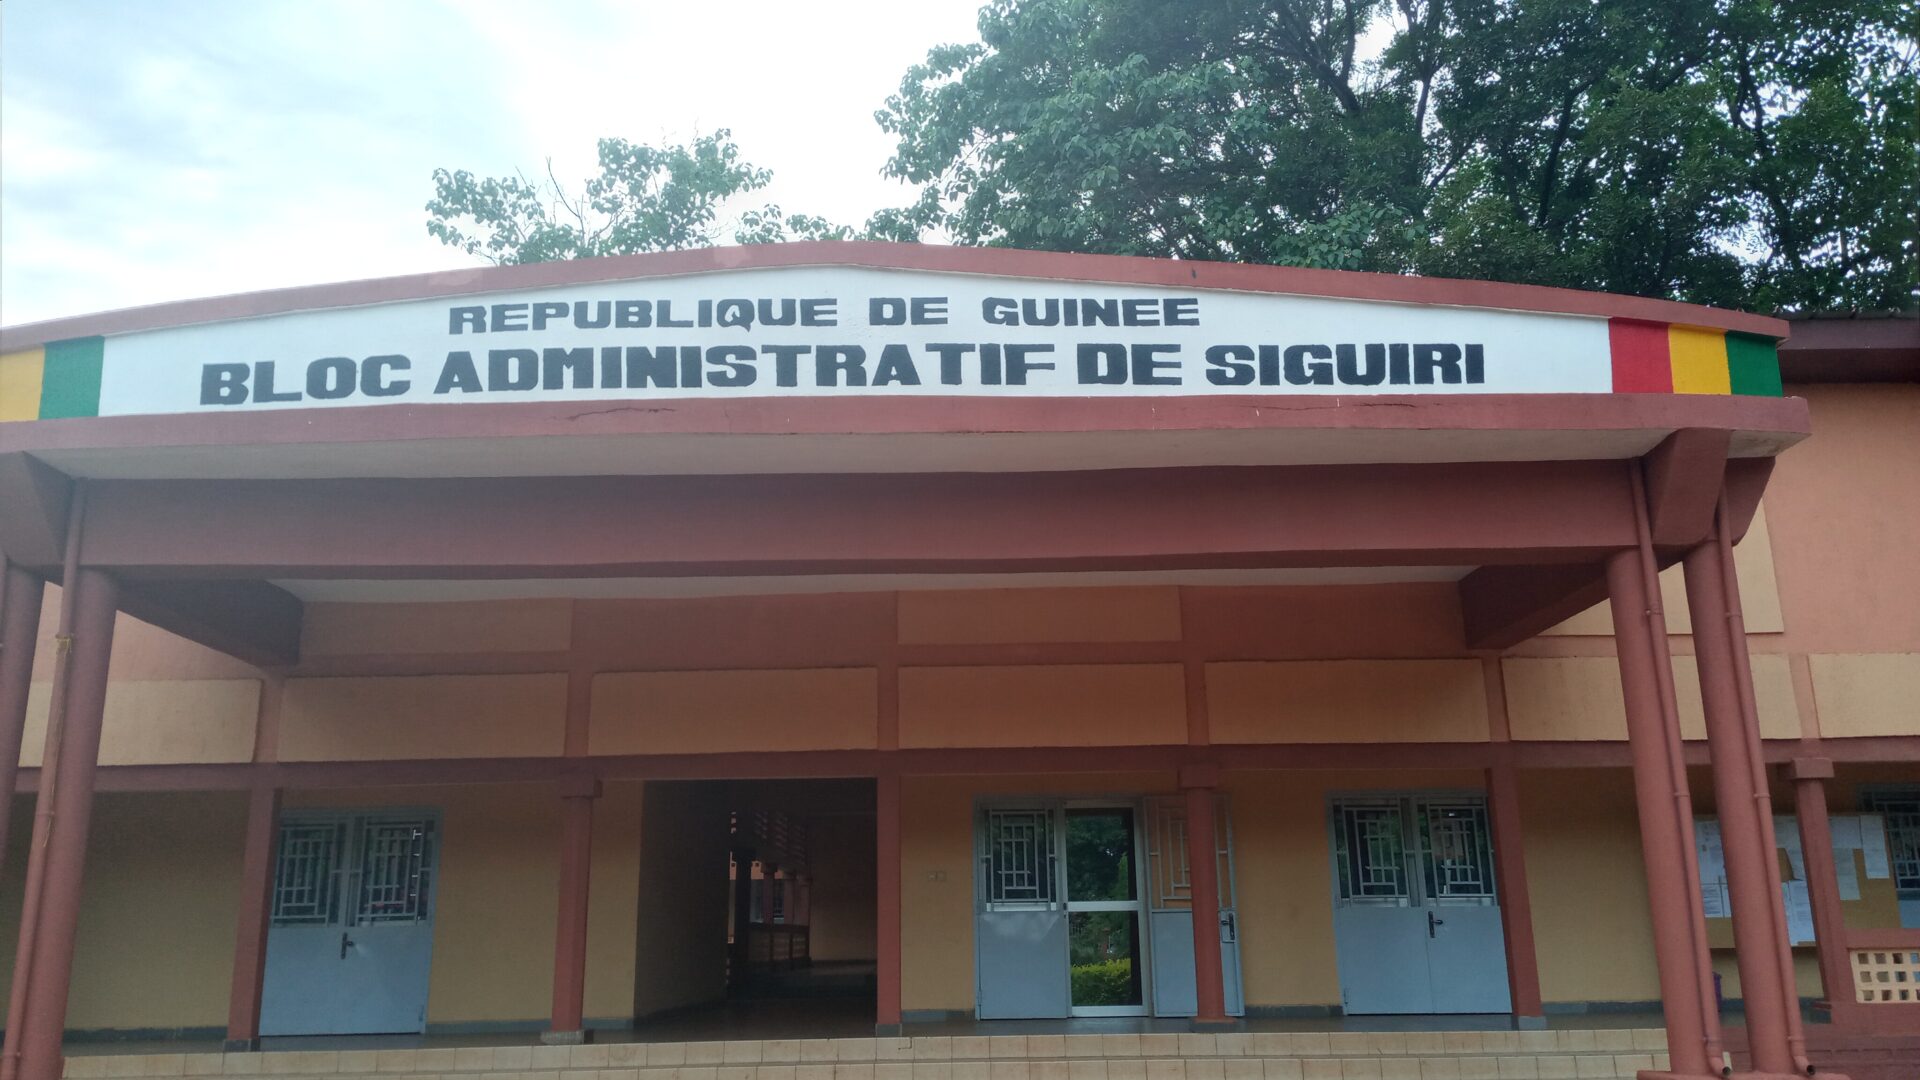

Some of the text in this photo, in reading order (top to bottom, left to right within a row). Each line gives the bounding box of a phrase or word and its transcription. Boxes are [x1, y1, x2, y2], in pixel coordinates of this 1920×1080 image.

[449, 297, 1200, 334] REPUBLIQUE DE GUINEE
[200, 343, 1485, 405] BLOC ADMINISTRATIF DE SIGUIRI
